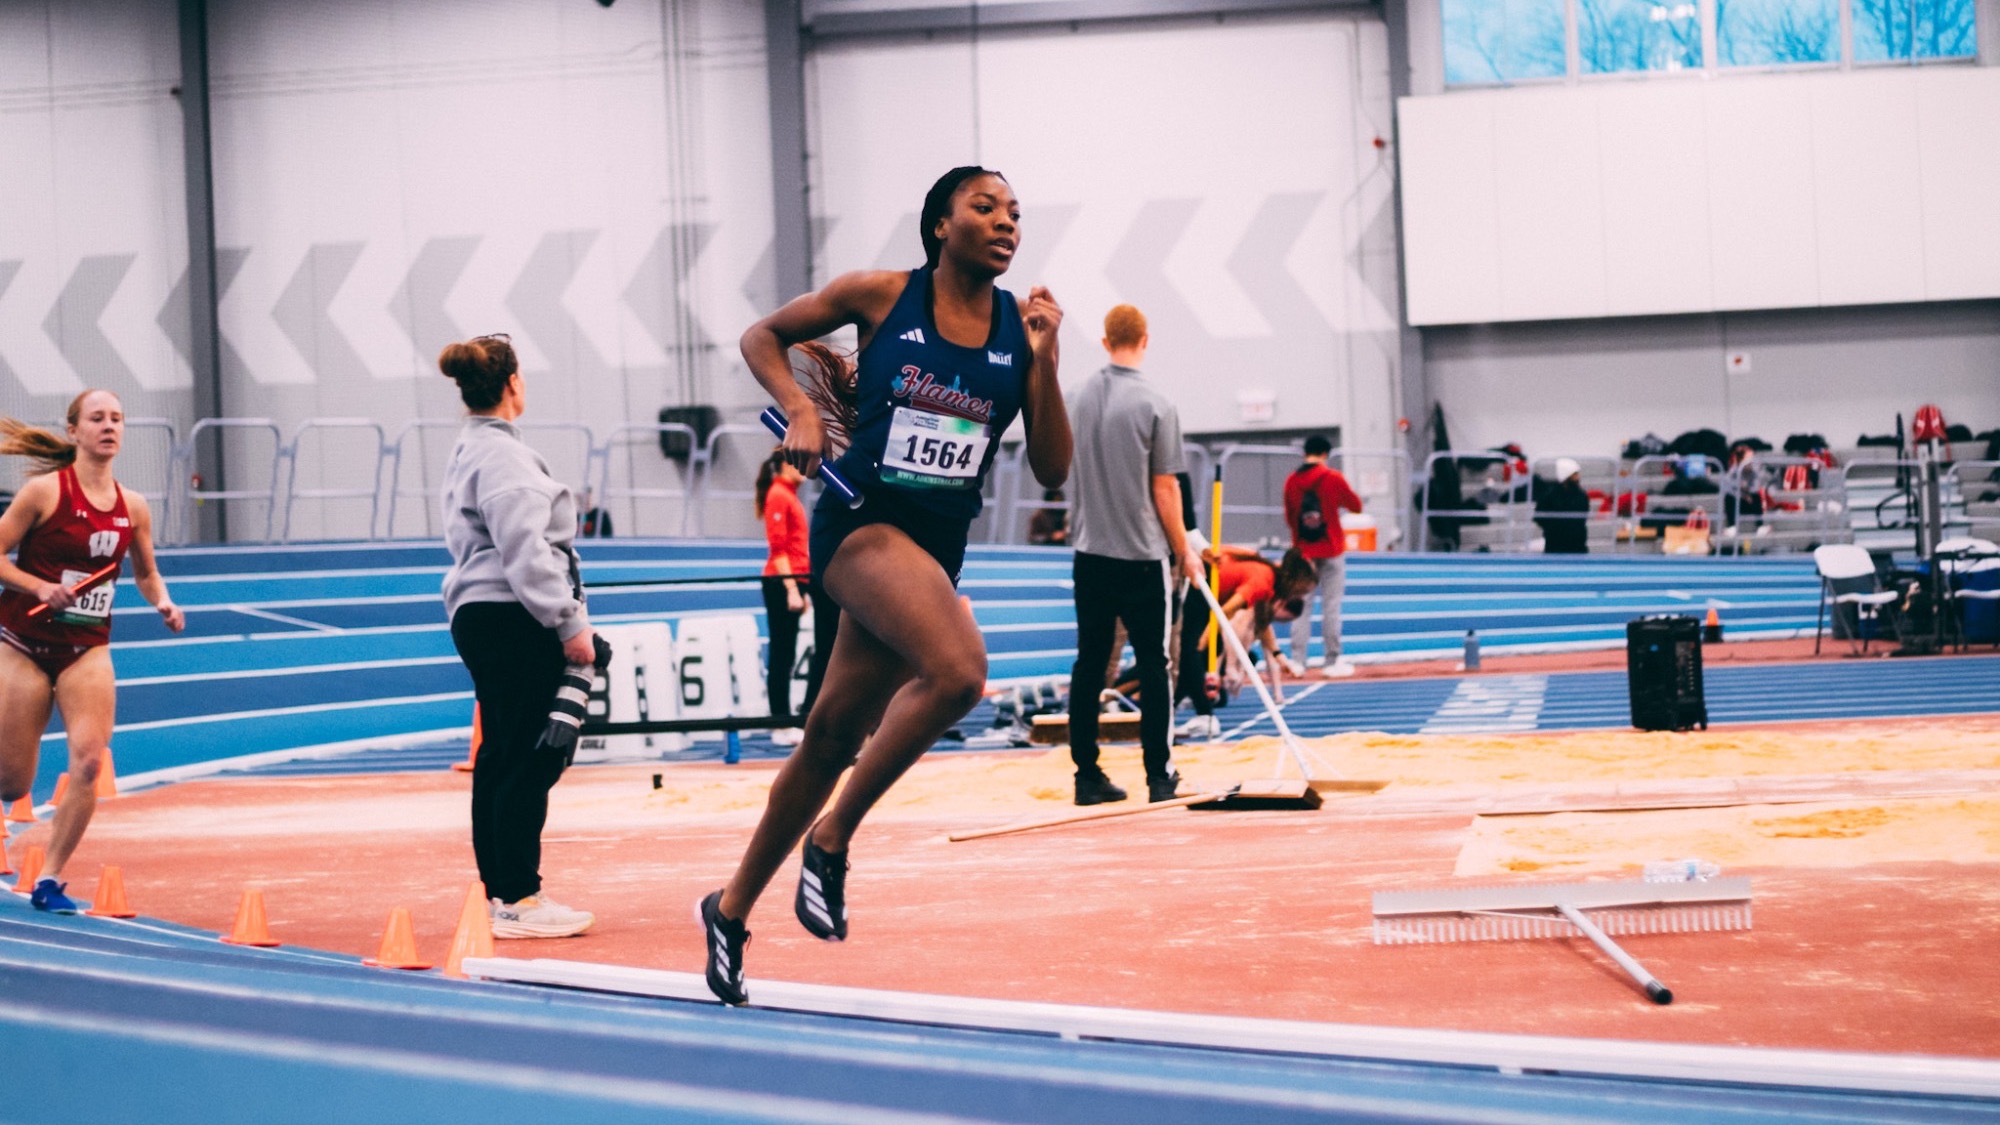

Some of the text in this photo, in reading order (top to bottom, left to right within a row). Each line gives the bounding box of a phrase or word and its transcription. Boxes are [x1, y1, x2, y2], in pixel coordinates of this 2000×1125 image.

[894, 365, 993, 418] Flames
[902, 434, 974, 470] 1564
[89, 530, 120, 558] W
[73, 592, 108, 612] 615
[680, 655, 705, 707] 6
